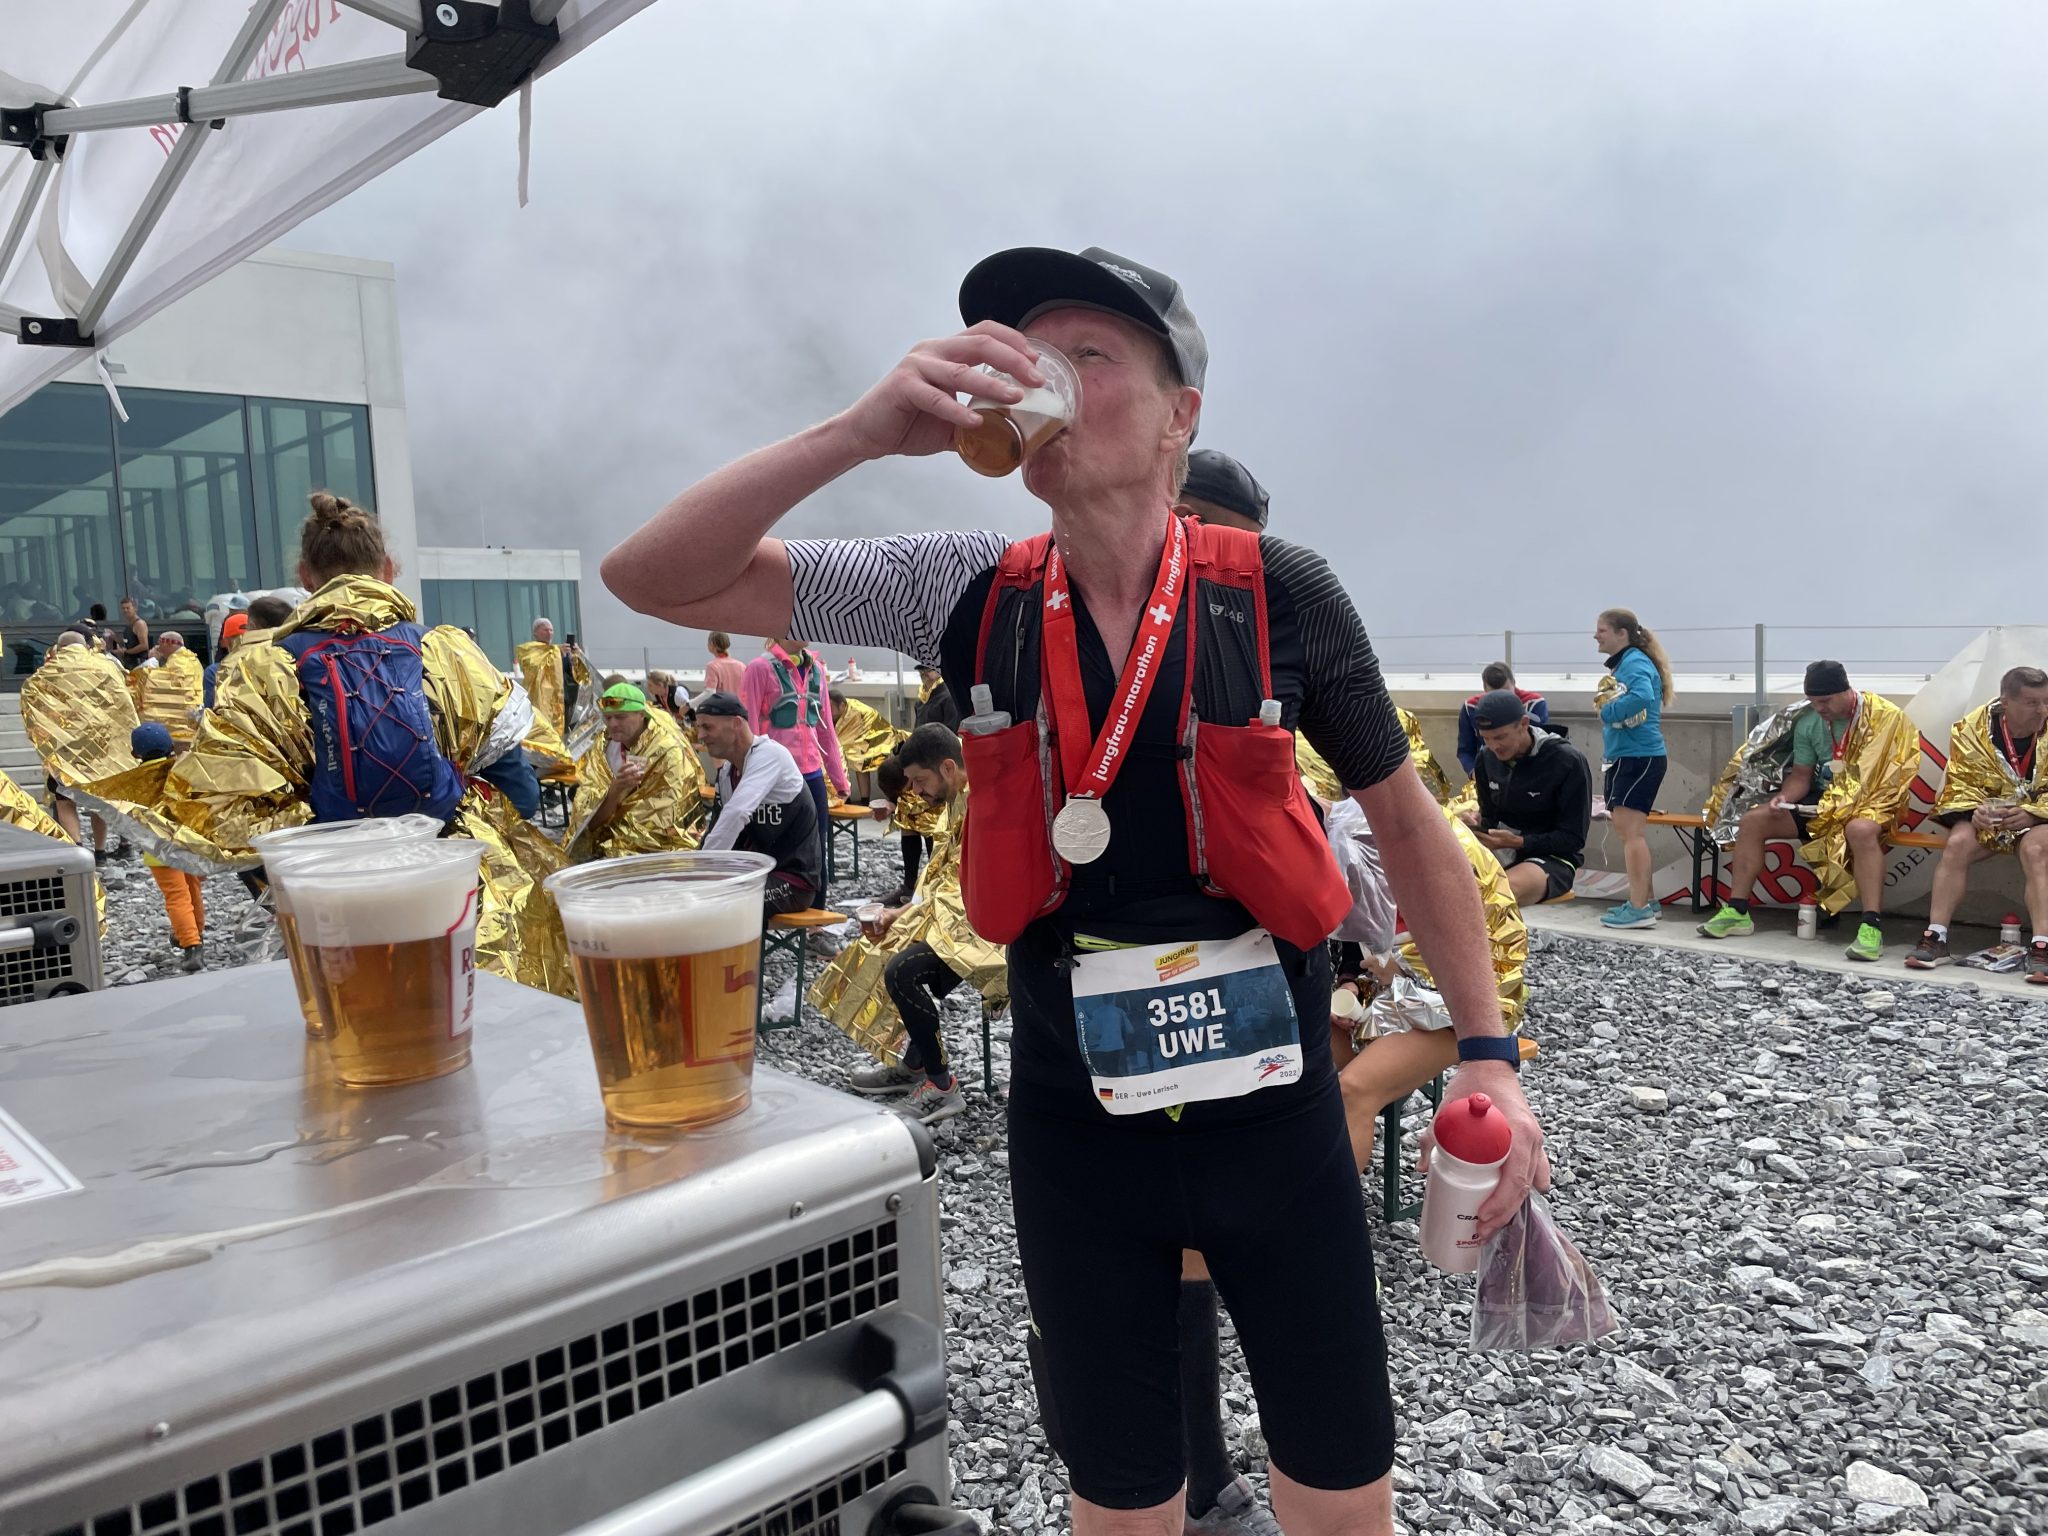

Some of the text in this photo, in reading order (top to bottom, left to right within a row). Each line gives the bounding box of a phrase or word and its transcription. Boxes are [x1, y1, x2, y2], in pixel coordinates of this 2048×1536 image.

[1092, 635, 1158, 782] jungfrau-marathon
[1159, 944, 1195, 966] JUNGFRAU
[1147, 988, 1226, 1027] 3581
[1158, 1022, 1226, 1059] UWE
[1279, 1069, 1297, 1078] 2022
[1115, 1092, 1129, 1100] GER
[1136, 1090, 1151, 1098] Uwe
